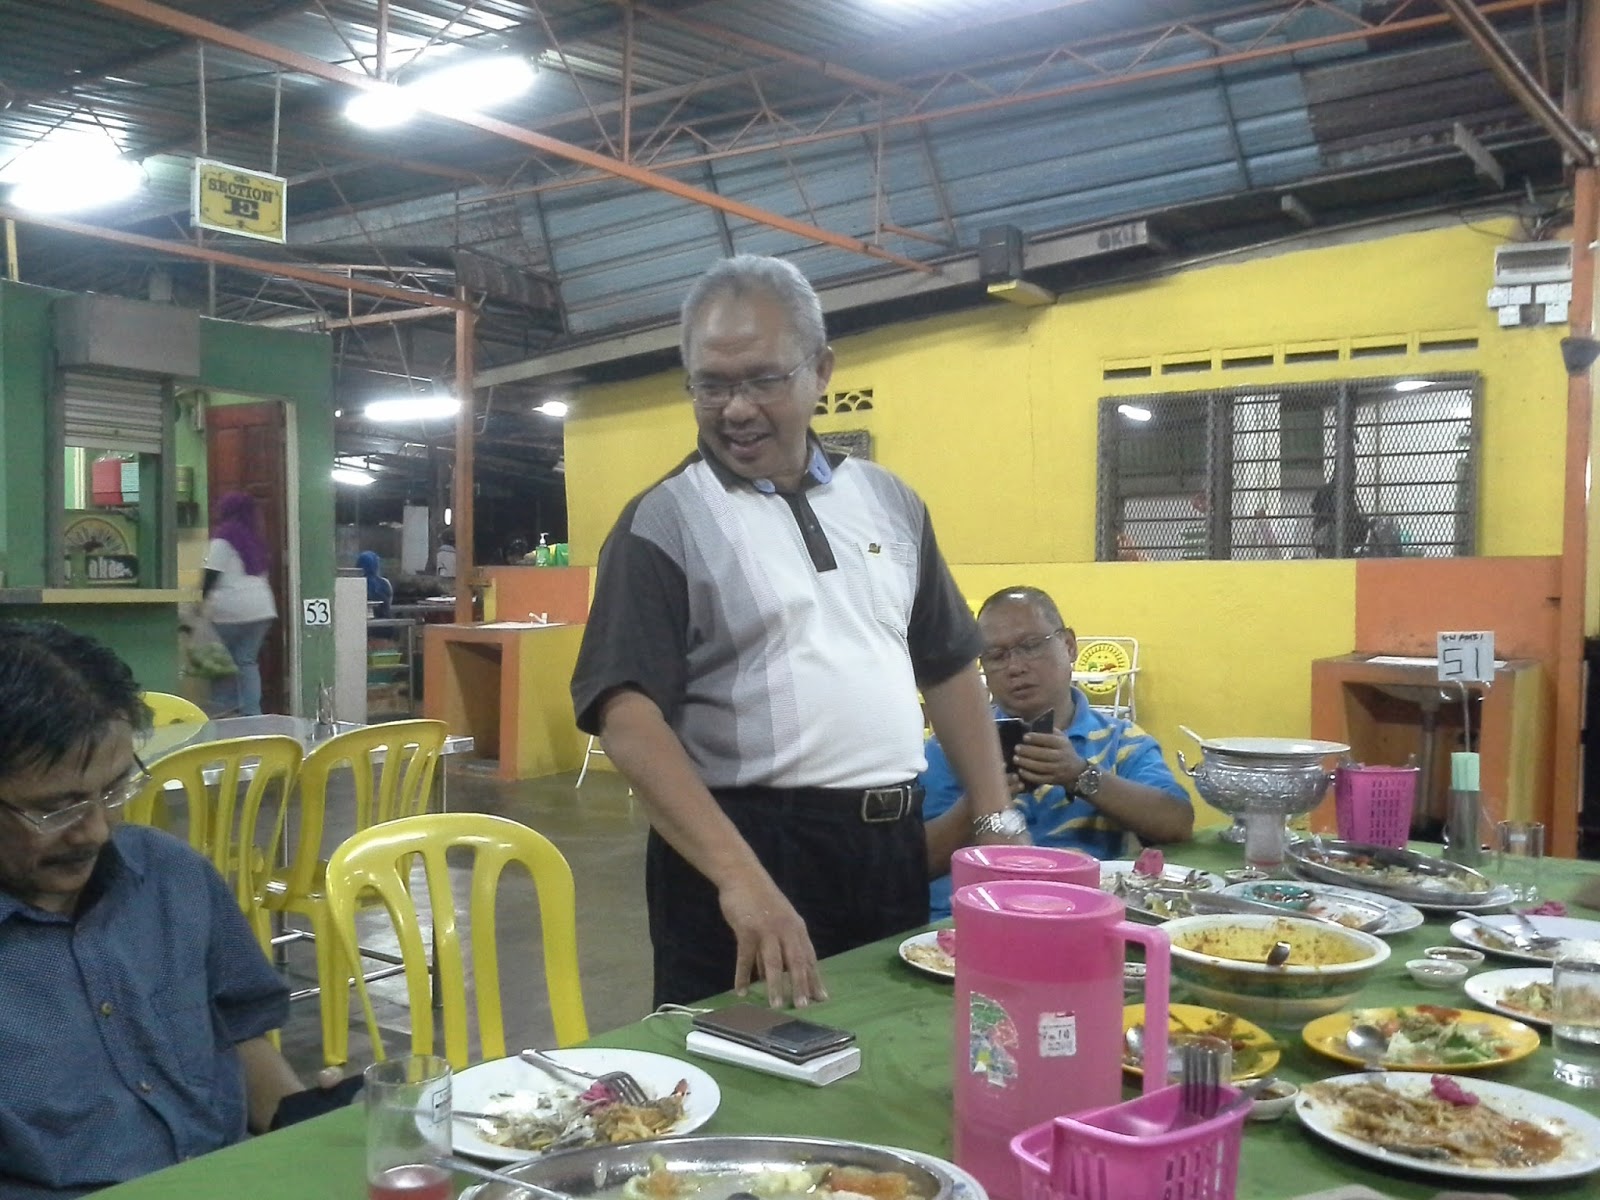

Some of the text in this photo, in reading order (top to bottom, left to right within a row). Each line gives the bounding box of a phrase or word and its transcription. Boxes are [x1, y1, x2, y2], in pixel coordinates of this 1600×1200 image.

[207, 178, 273, 204] SECTION
[224, 195, 260, 221] E
[306, 602, 329, 624] 53
